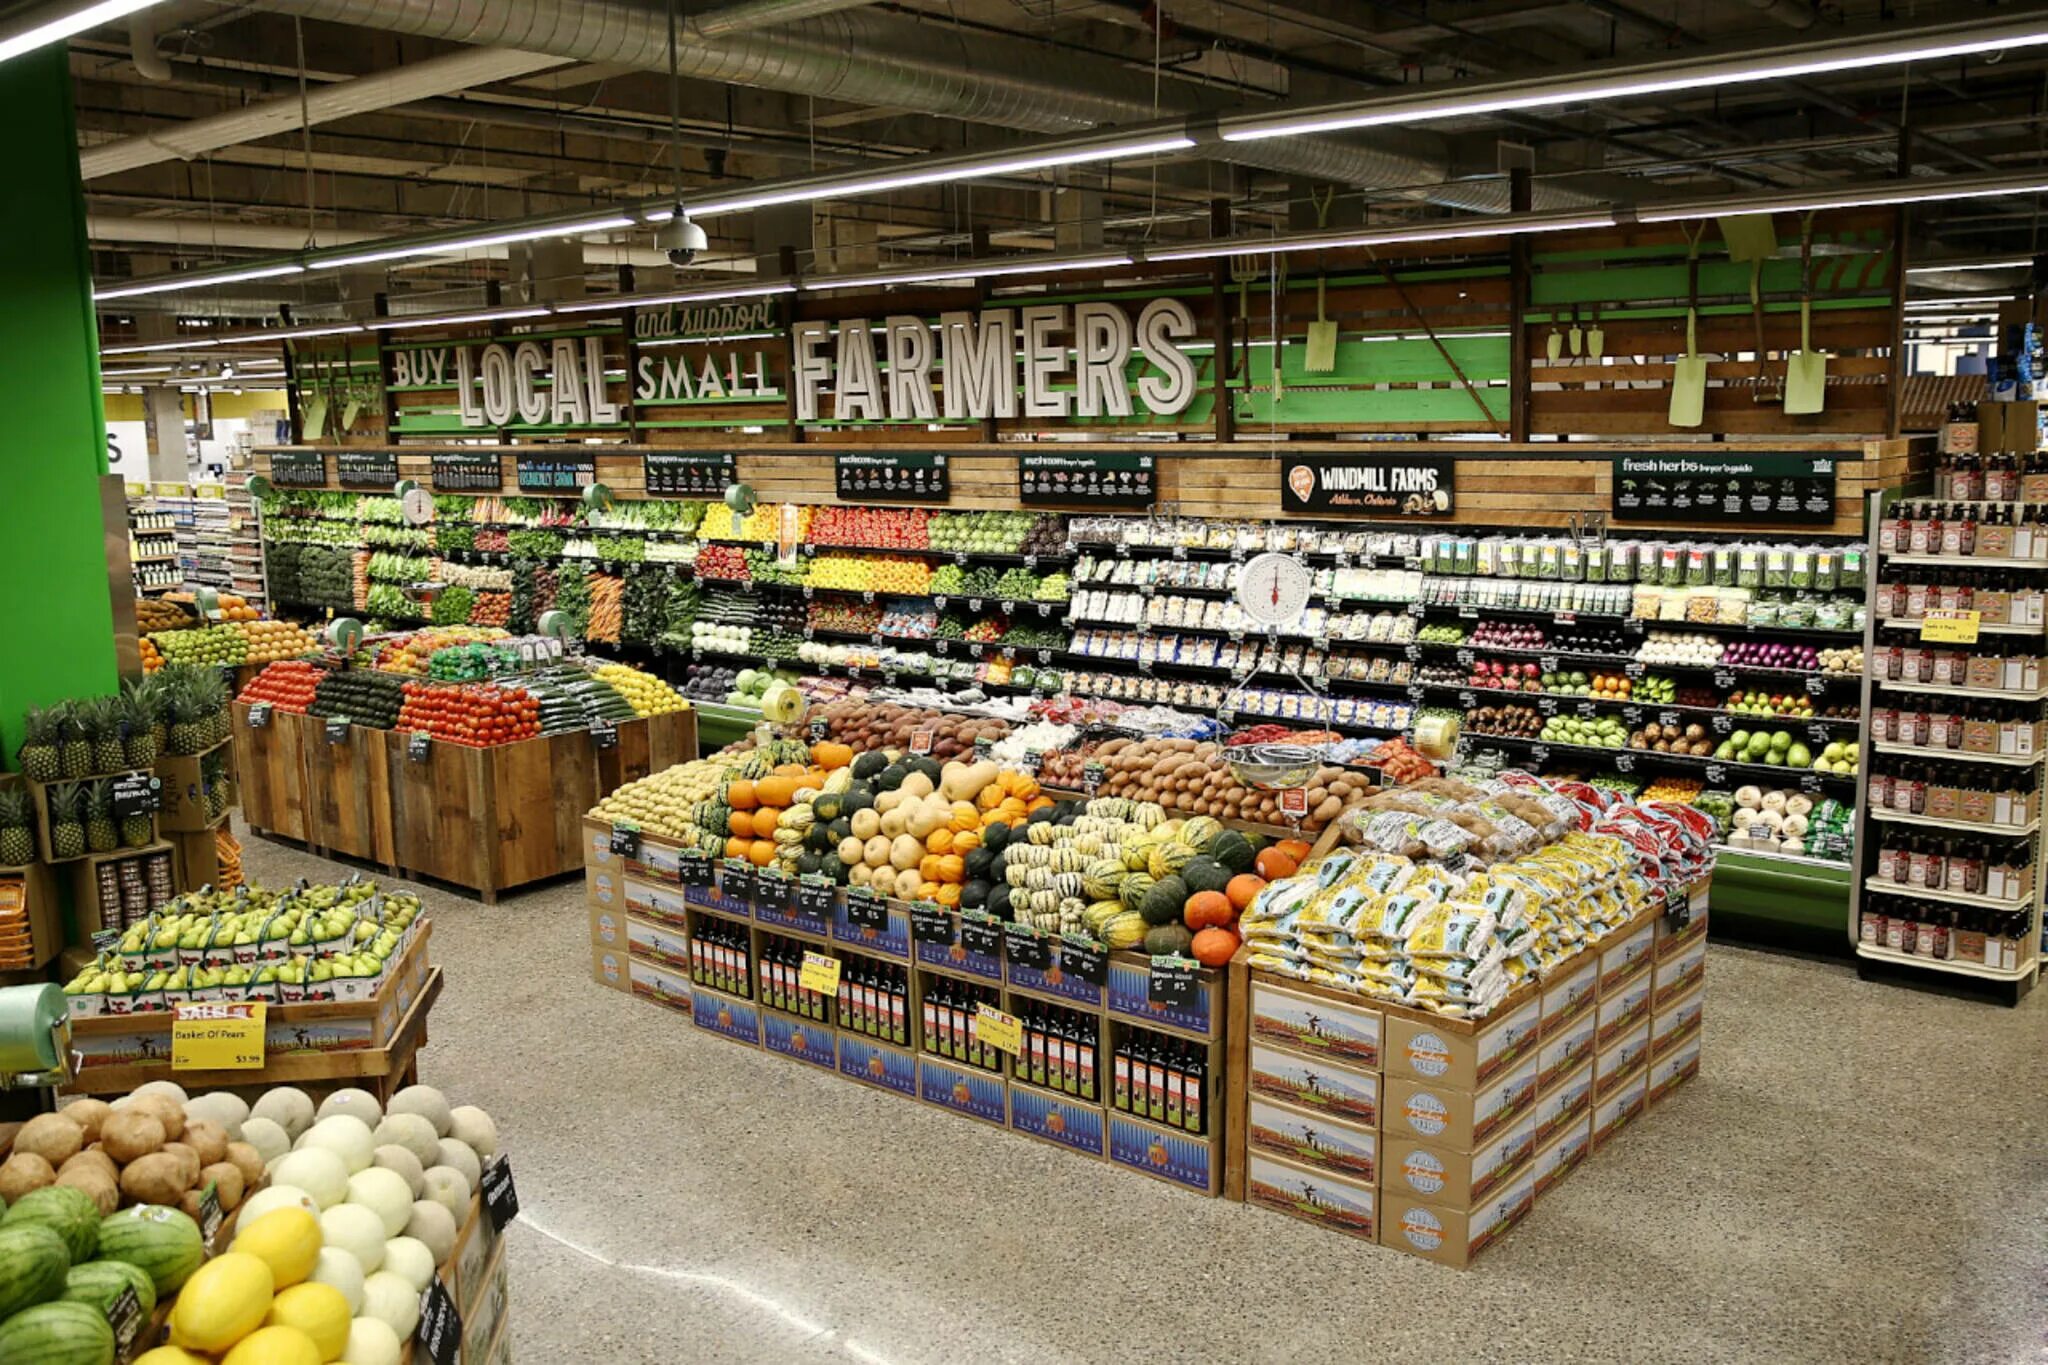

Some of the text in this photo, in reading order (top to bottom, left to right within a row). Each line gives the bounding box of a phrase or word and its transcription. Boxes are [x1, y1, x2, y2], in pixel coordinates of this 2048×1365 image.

[635, 294, 776, 346] and support
[395, 336, 622, 427] BUY LOCAL
[637, 351, 779, 400] SMALL
[792, 297, 1198, 420] FARMERS
[1320, 467, 1439, 492] WINDMILL FARMS
[1622, 458, 1658, 472] fresh
[1659, 458, 1698, 473] herbs
[175, 1030, 246, 1039] Basket Of Pears
